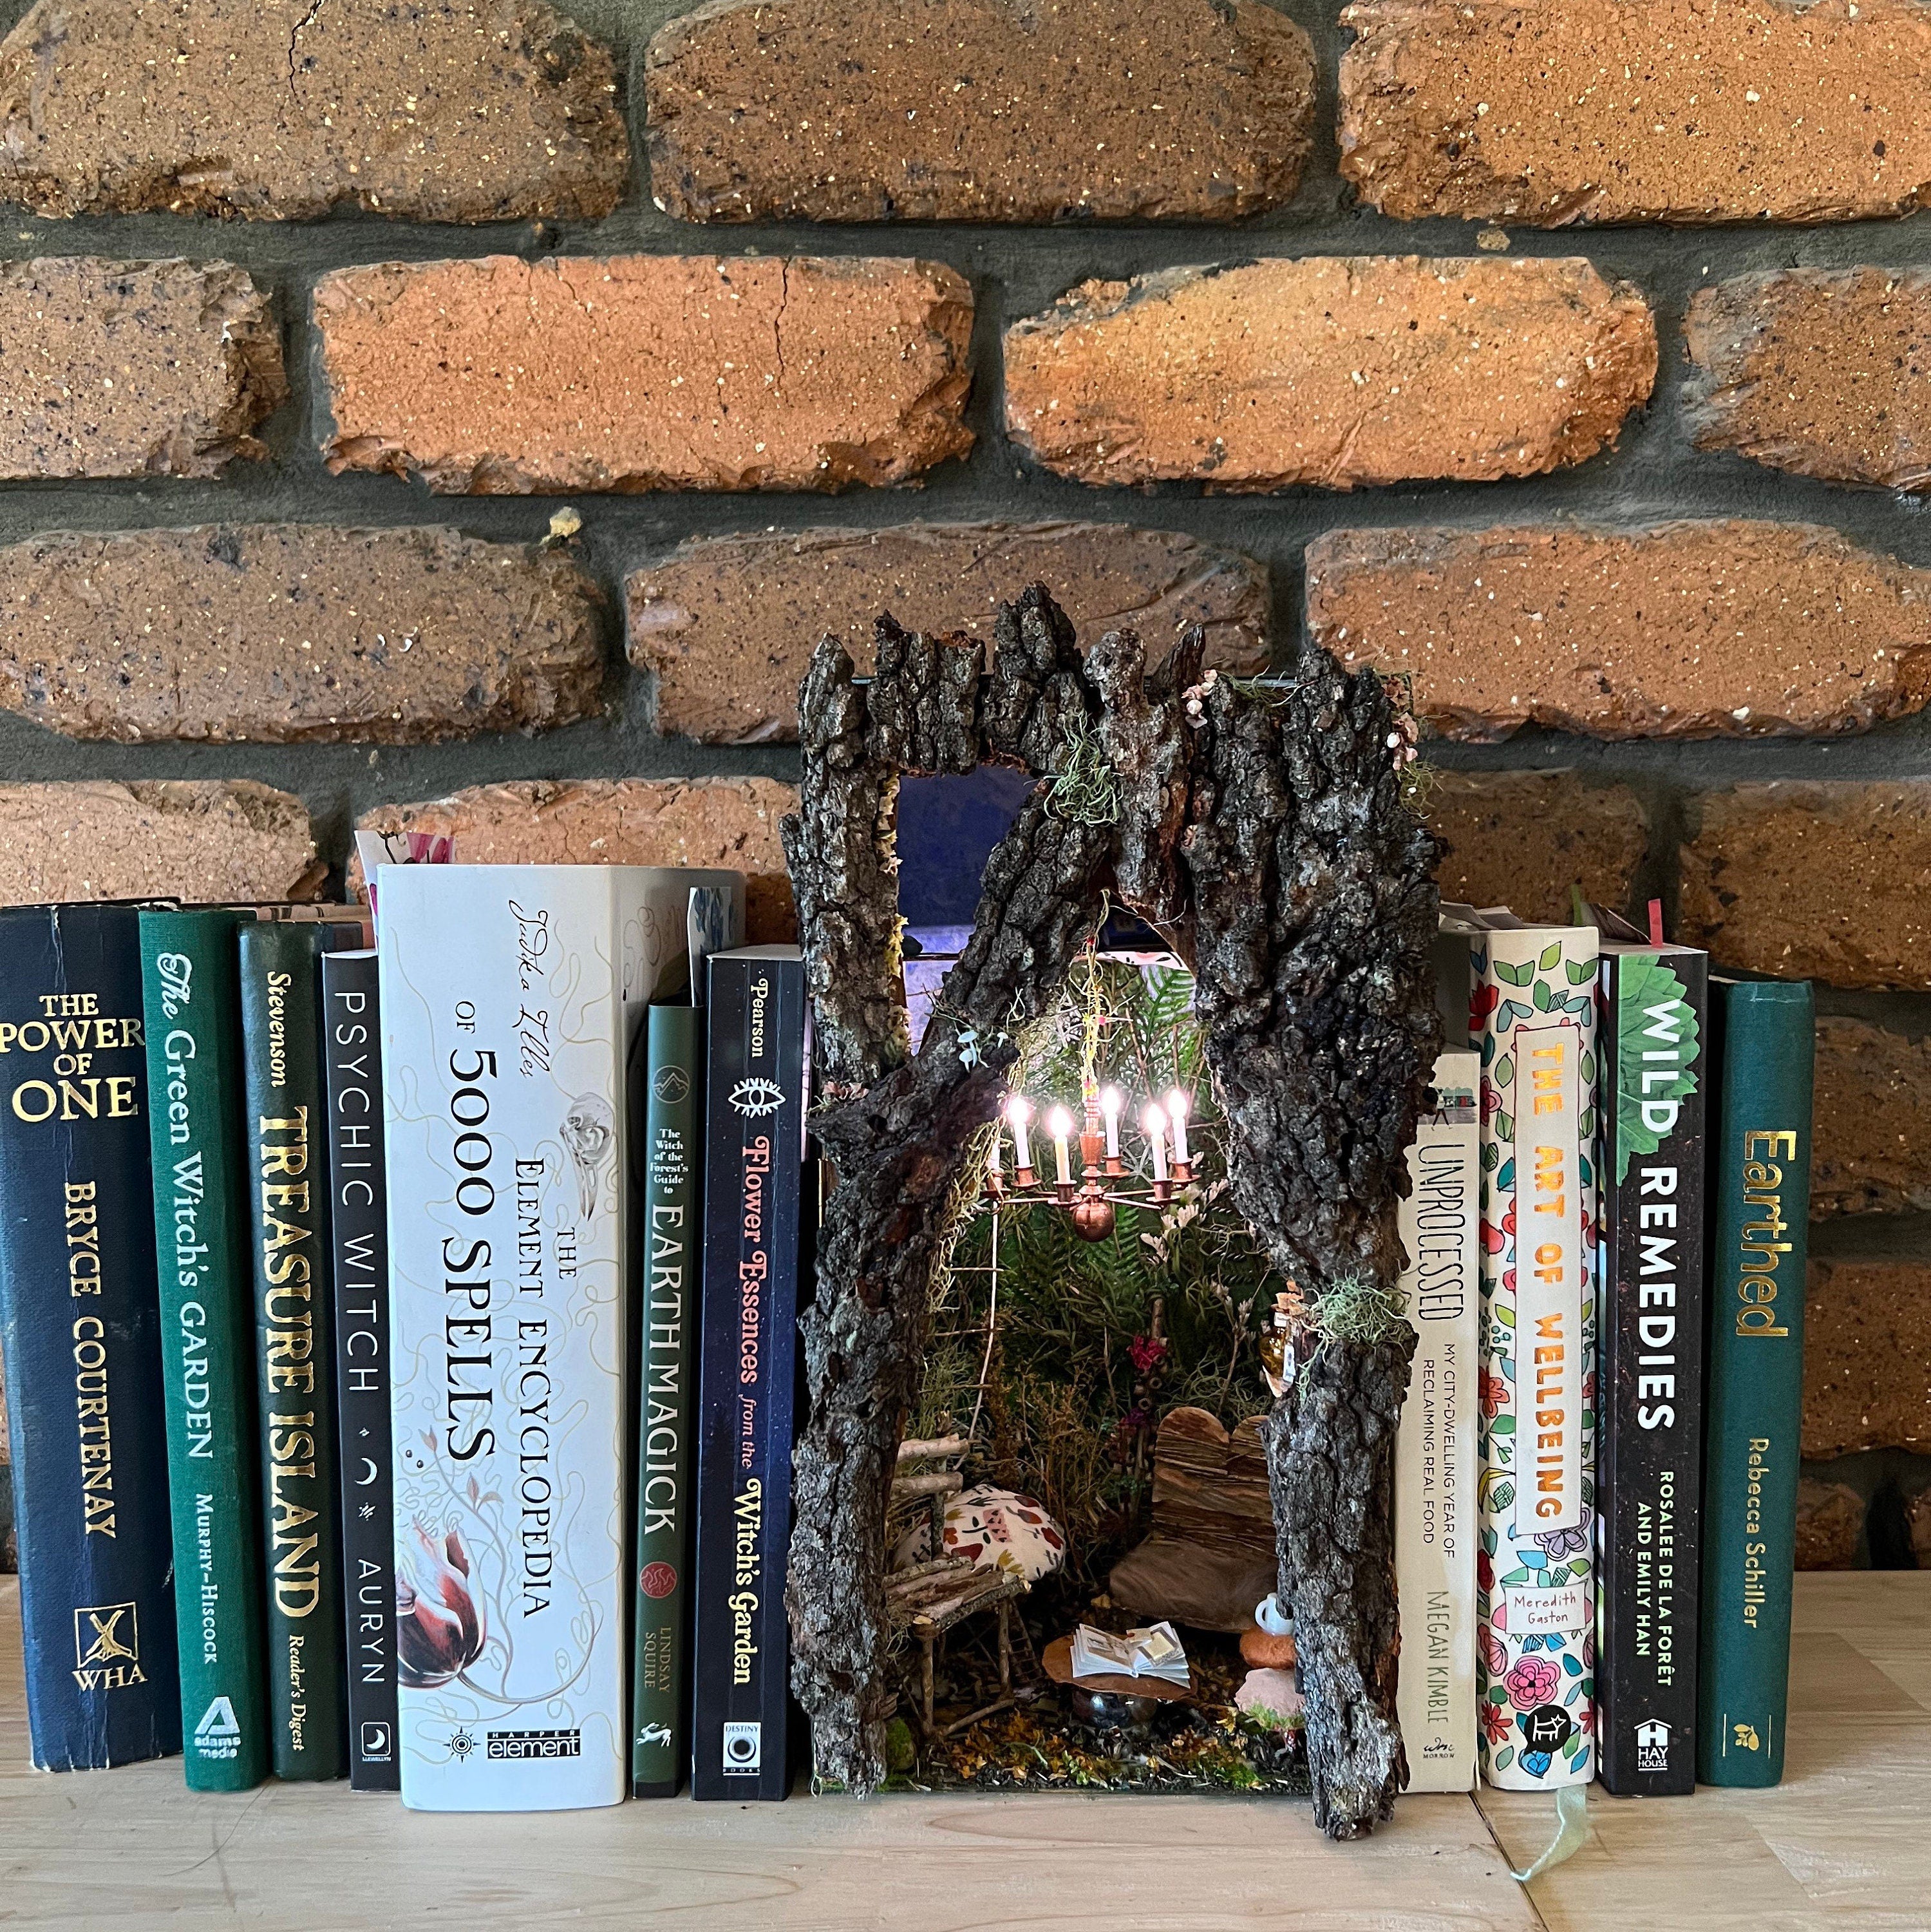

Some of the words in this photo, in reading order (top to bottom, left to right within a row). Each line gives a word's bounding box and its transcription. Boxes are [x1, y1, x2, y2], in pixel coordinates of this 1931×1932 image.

[39, 994, 99, 1017] THE
[156, 952, 193, 1019] The
[454, 1000, 476, 1034] OF
[751, 977, 769, 1058] Pearson
[0, 1018, 146, 1053] POWER
[267, 971, 293, 1088] Stevenson
[53, 1053, 93, 1076] OF
[165, 1029, 196, 1145] Green
[1532, 1042, 1565, 1115] THE
[1640, 998, 1683, 1133] WILD
[12, 1077, 138, 1122] ONE
[334, 992, 375, 1206] PSYCHIC
[449, 1049, 498, 1216] 5000
[654, 1151, 666, 1161] of
[668, 1152, 683, 1161] the
[655, 1140, 683, 1150] Witch
[659, 1128, 681, 1138] The
[650, 1162, 689, 1172] Forest's
[654, 1174, 684, 1184] Guide
[742, 1134, 770, 1239] Flower
[1534, 1146, 1566, 1218] ART
[65, 1181, 102, 1297] BRYCE
[172, 1150, 210, 1288] Witch's
[259, 1105, 314, 1394] TREASURE
[514, 1157, 546, 1298] ELEMENT
[1418, 1144, 1465, 1321] UNPROCESSED
[1736, 1130, 1798, 1338] Earthed
[556, 1226, 577, 1280] THE
[650, 1204, 683, 1350] EARTH
[1534, 1243, 1563, 1284] OF
[342, 1233, 380, 1392] WITCH
[738, 1251, 768, 1384] Essences
[1638, 1167, 1678, 1430] REMEDIES
[179, 1301, 214, 1459] GARDEN
[442, 1236, 496, 1461] SPELLS
[1444, 1344, 1455, 1365] MY
[73, 1316, 117, 1539] COURTENAY
[739, 1394, 756, 1435] from
[1424, 1359, 1435, 1452] RECLAIMING
[1444, 1370, 1455, 1488] CITY-DWELLING
[1534, 1312, 1565, 1519] WELLBEING
[518, 1319, 552, 1619] ENCYCLOPEDIA
[643, 1363, 679, 1536] MAGICK
[742, 1440, 755, 1467] the
[1424, 1457, 1435, 1496] REAL
[268, 1410, 321, 1618] ISLAND
[1444, 1493, 1455, 1533] YEAR
[1659, 1471, 1674, 1557] ROSALEE
[1746, 1437, 1769, 1533] Rebecca
[735, 1478, 762, 1586] Witch's
[1424, 1501, 1435, 1543] FOOD
[1444, 1538, 1455, 1558] OF
[1637, 1501, 1652, 1544] AND
[193, 1493, 218, 1665] MURPHY-HISCOCK
[1514, 1591, 1576, 1608] Meredith
[1637, 1551, 1652, 1608] EMILY
[1658, 1596, 1672, 1619] LA
[1659, 1564, 1673, 1589] DE
[1744, 1542, 1766, 1628] Schiller
[357, 1558, 386, 1683] AURYN
[729, 1594, 760, 1685] Garden
[1427, 1591, 1449, 1659] MEGAN
[1528, 1611, 1568, 1625] Gaston
[1636, 1615, 1651, 1656] HAN
[71, 1668, 148, 1692] WHA
[288, 1634, 306, 1698] Reader's
[644, 1633, 656, 1689] SQUIRE
[659, 1627, 671, 1693] LINDSAY
[1657, 1625, 1675, 1686] FORÊT
[289, 1703, 306, 1751] Digest
[1427, 1667, 1449, 1724] KIMBLE
[489, 1738, 579, 1757] element
[493, 1730, 575, 1739] HARPER
[1638, 1747, 1669, 1759] HAY
